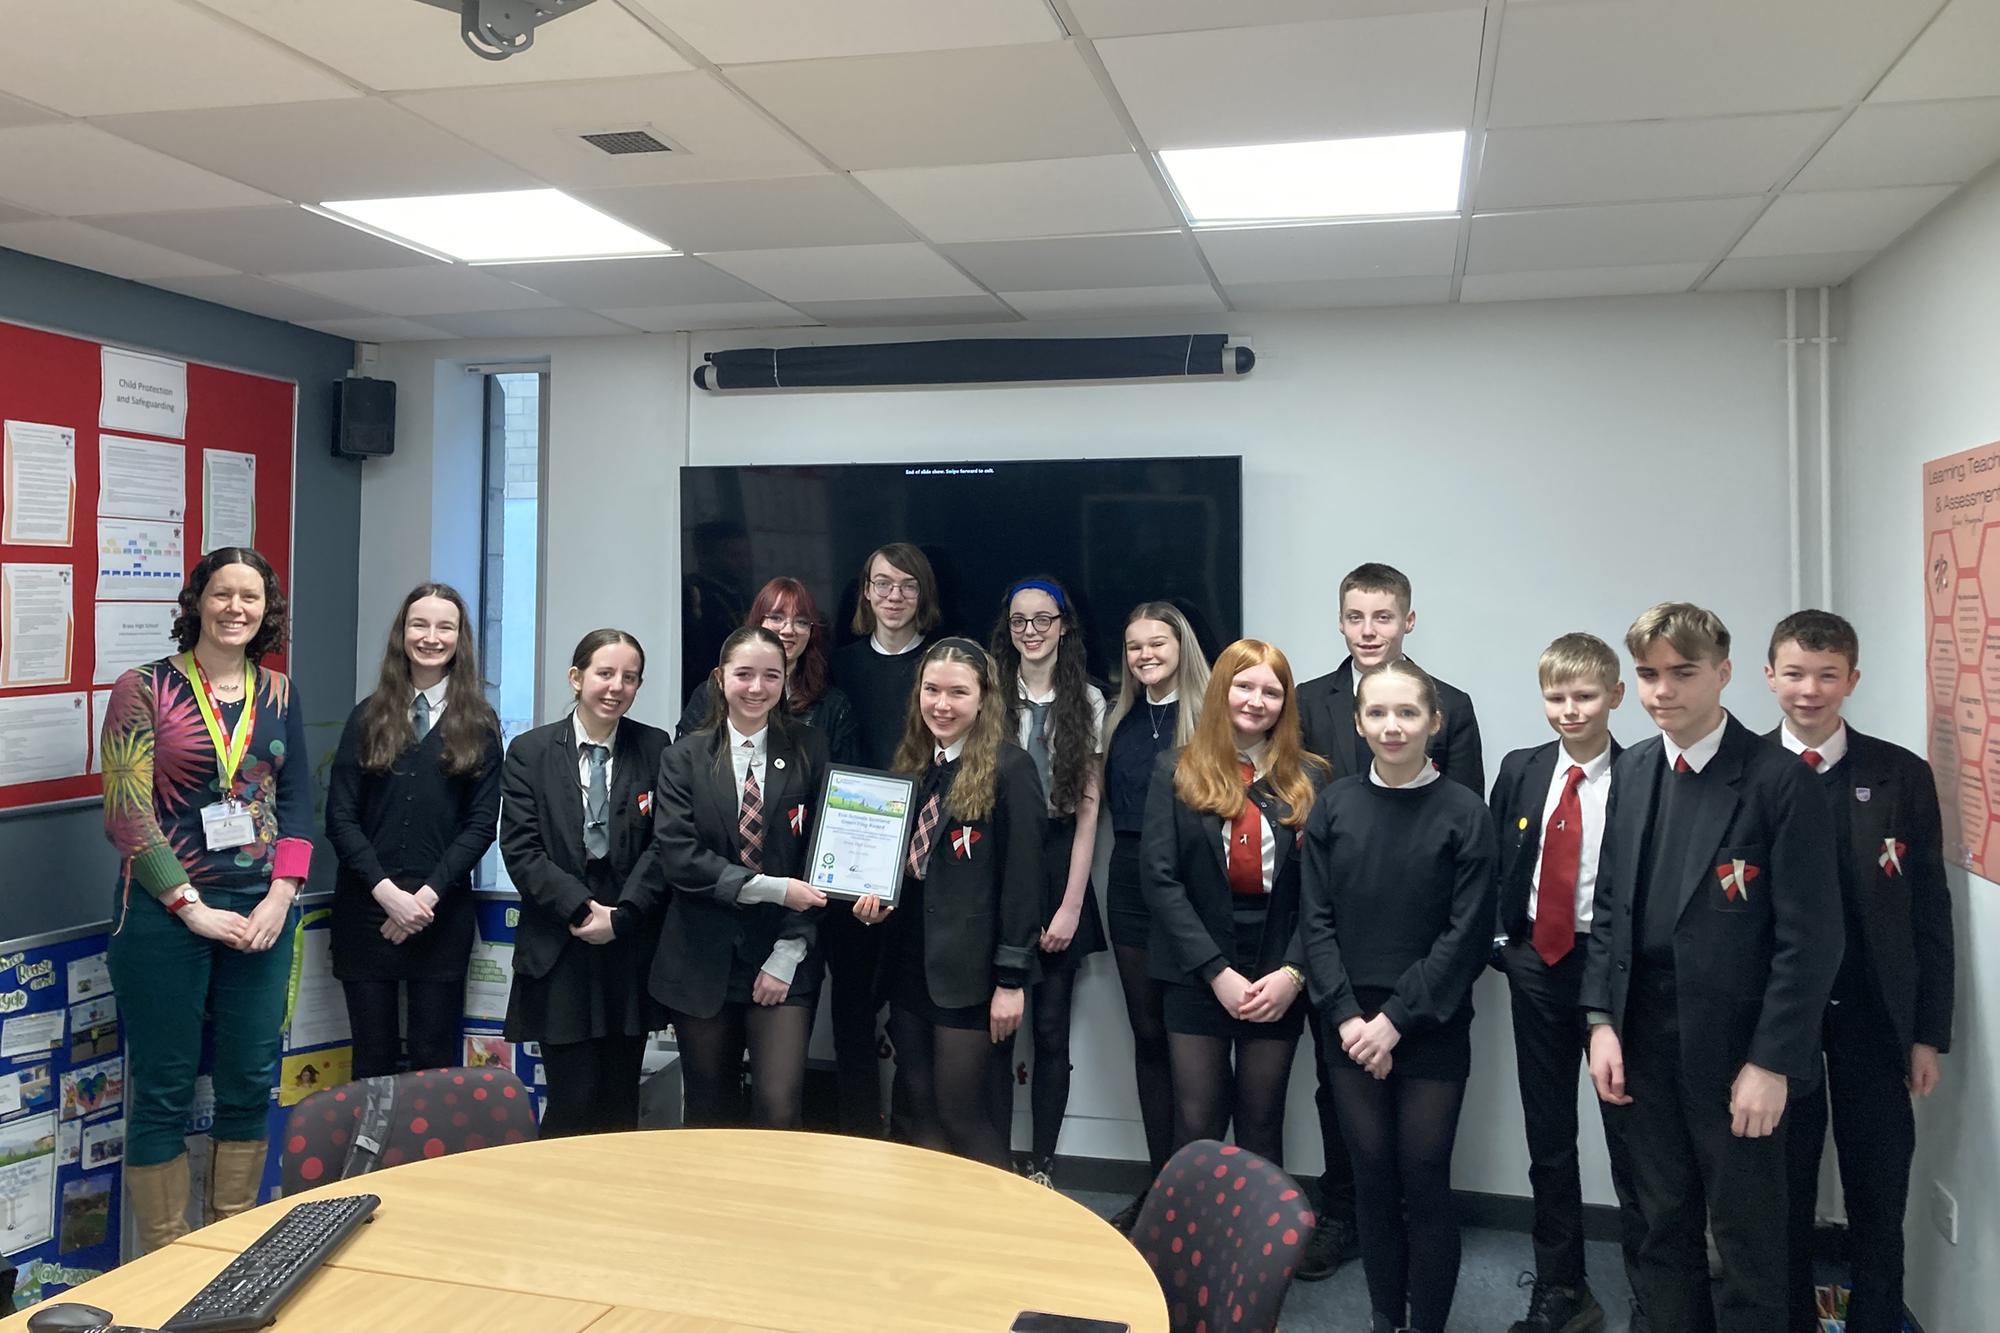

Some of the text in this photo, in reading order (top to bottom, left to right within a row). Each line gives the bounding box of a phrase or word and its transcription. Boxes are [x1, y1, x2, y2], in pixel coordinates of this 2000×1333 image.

[118, 378, 173, 395] Child Protection
[116, 395, 175, 413] and Safeguarding
[1928, 464, 1966, 485] Learning
[0, 991, 25, 1009] ycle
